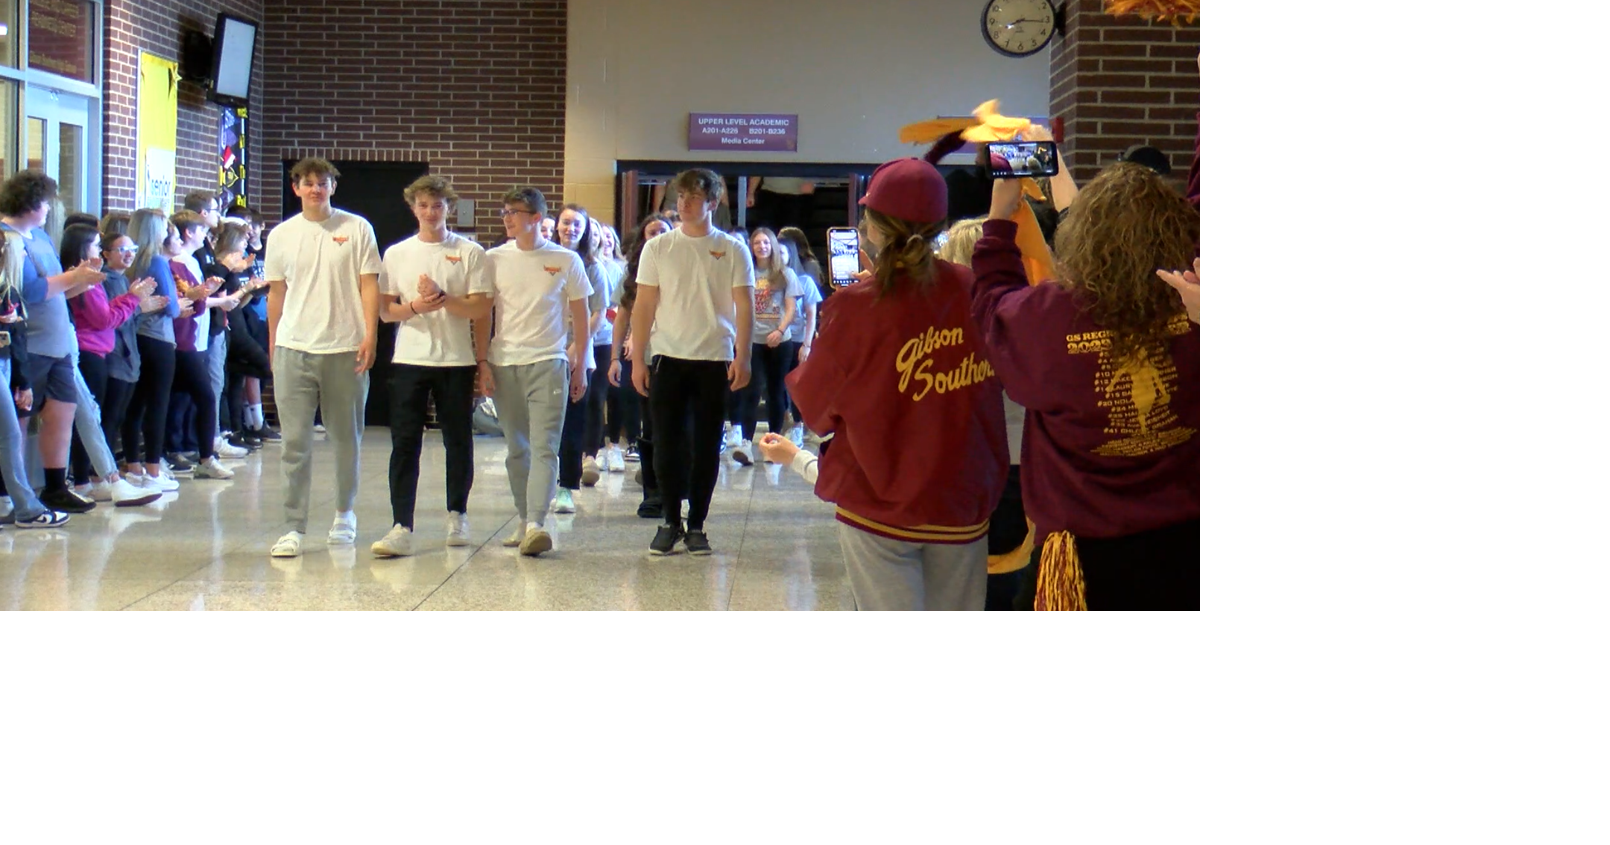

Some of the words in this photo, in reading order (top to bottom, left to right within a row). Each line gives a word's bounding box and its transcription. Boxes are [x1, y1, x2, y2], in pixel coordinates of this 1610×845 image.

[698, 118, 724, 126] UPPER
[725, 119, 748, 127] LEVEL
[749, 119, 789, 127] ACADEMIC
[721, 137, 742, 145] Media
[1066, 334, 1081, 342] GS
[896, 326, 964, 393] Gibson
[912, 352, 995, 402] Souther
